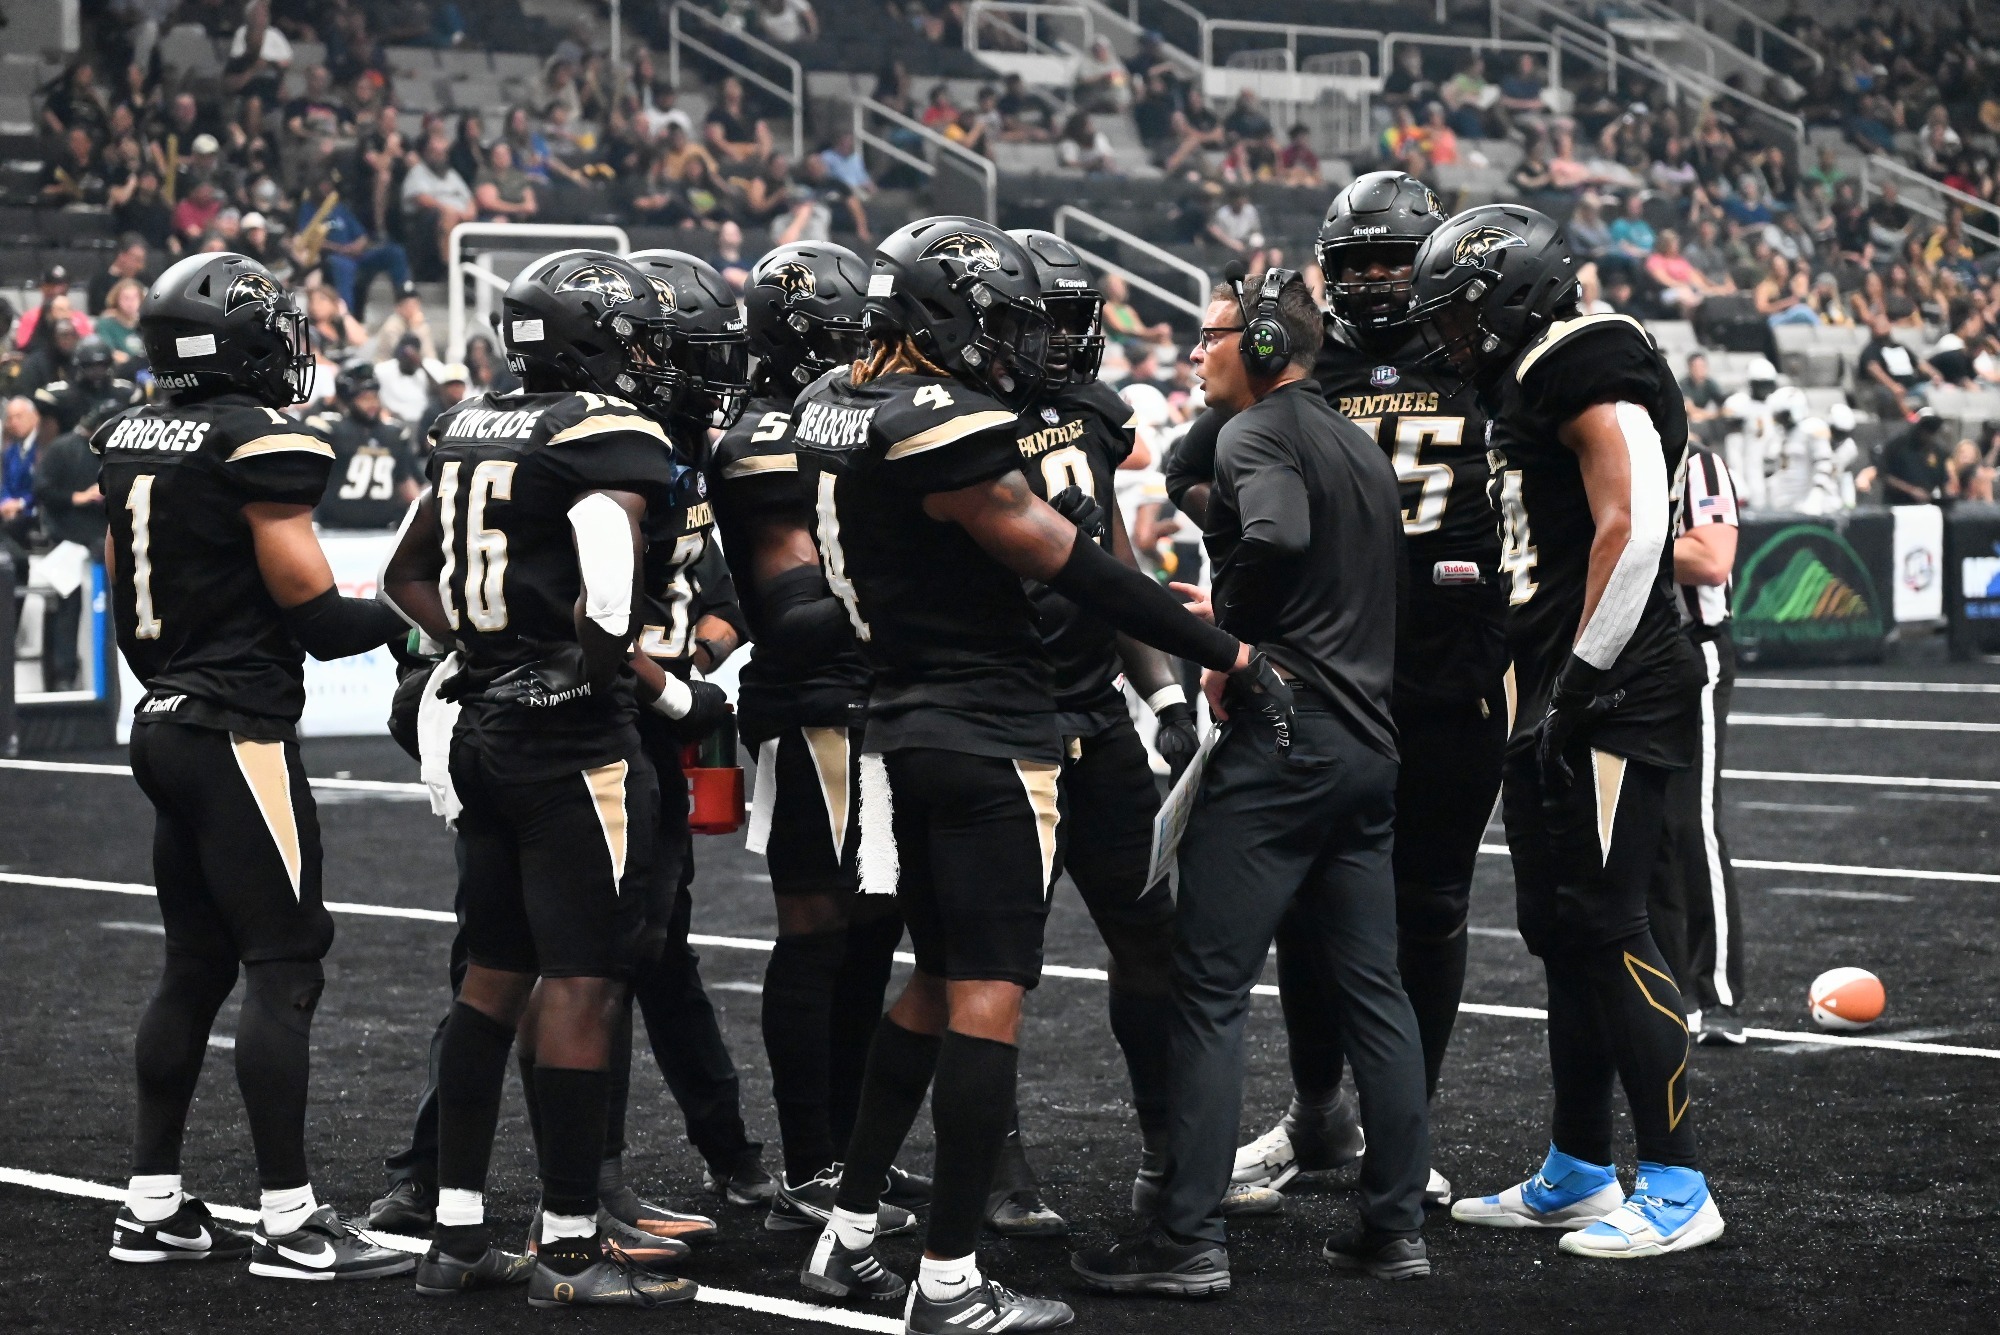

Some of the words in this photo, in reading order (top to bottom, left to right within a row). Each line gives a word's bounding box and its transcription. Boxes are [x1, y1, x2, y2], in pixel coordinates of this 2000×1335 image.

[912, 383, 955, 410] 4
[1340, 391, 1439, 418] PANTHERS
[106, 419, 211, 452] BRIDGES
[445, 408, 545, 439] KINCADE
[751, 411, 791, 443] 5
[795, 401, 876, 446] MEADOWS
[339, 453, 396, 500] 99
[125, 475, 162, 640] 1
[437, 460, 518, 632] 16
[1444, 564, 1476, 573] Riddell
